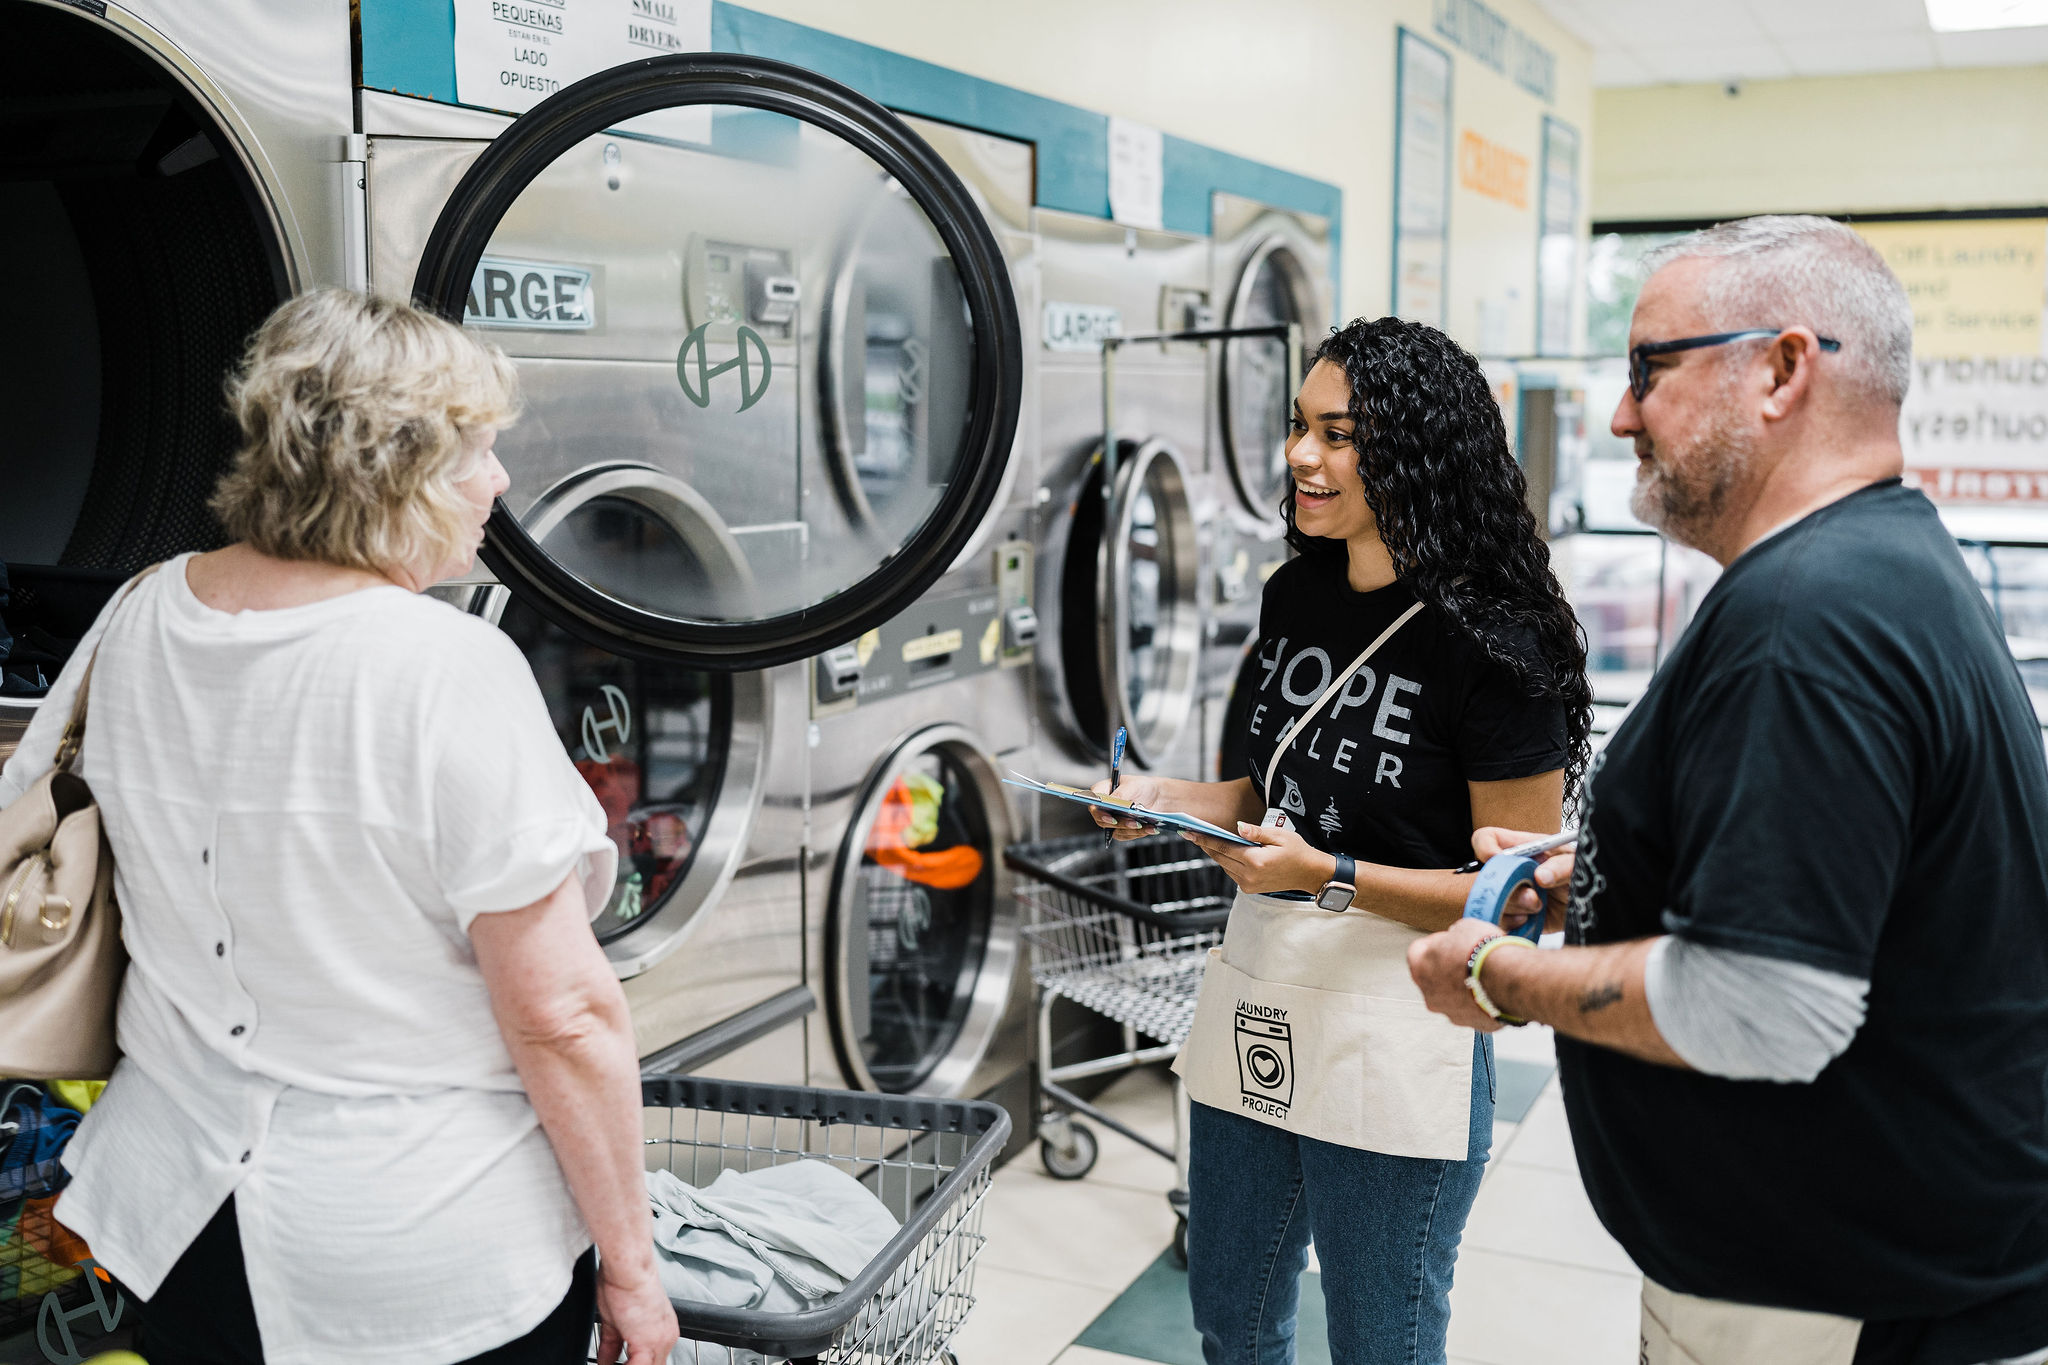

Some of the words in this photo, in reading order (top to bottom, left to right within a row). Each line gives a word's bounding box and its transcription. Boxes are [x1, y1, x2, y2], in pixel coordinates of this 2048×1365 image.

[492, 2, 563, 31] PEQUEÑAS
[632, 0, 677, 21] SMALL
[628, 24, 682, 49] DRYERS
[514, 47, 547, 67] LADO
[500, 71, 560, 93] OPUESTO
[1258, 637, 1423, 745] HOPE
[1236, 998, 1288, 1021] LAUNDRY
[1242, 1096, 1289, 1121] PROJECT
